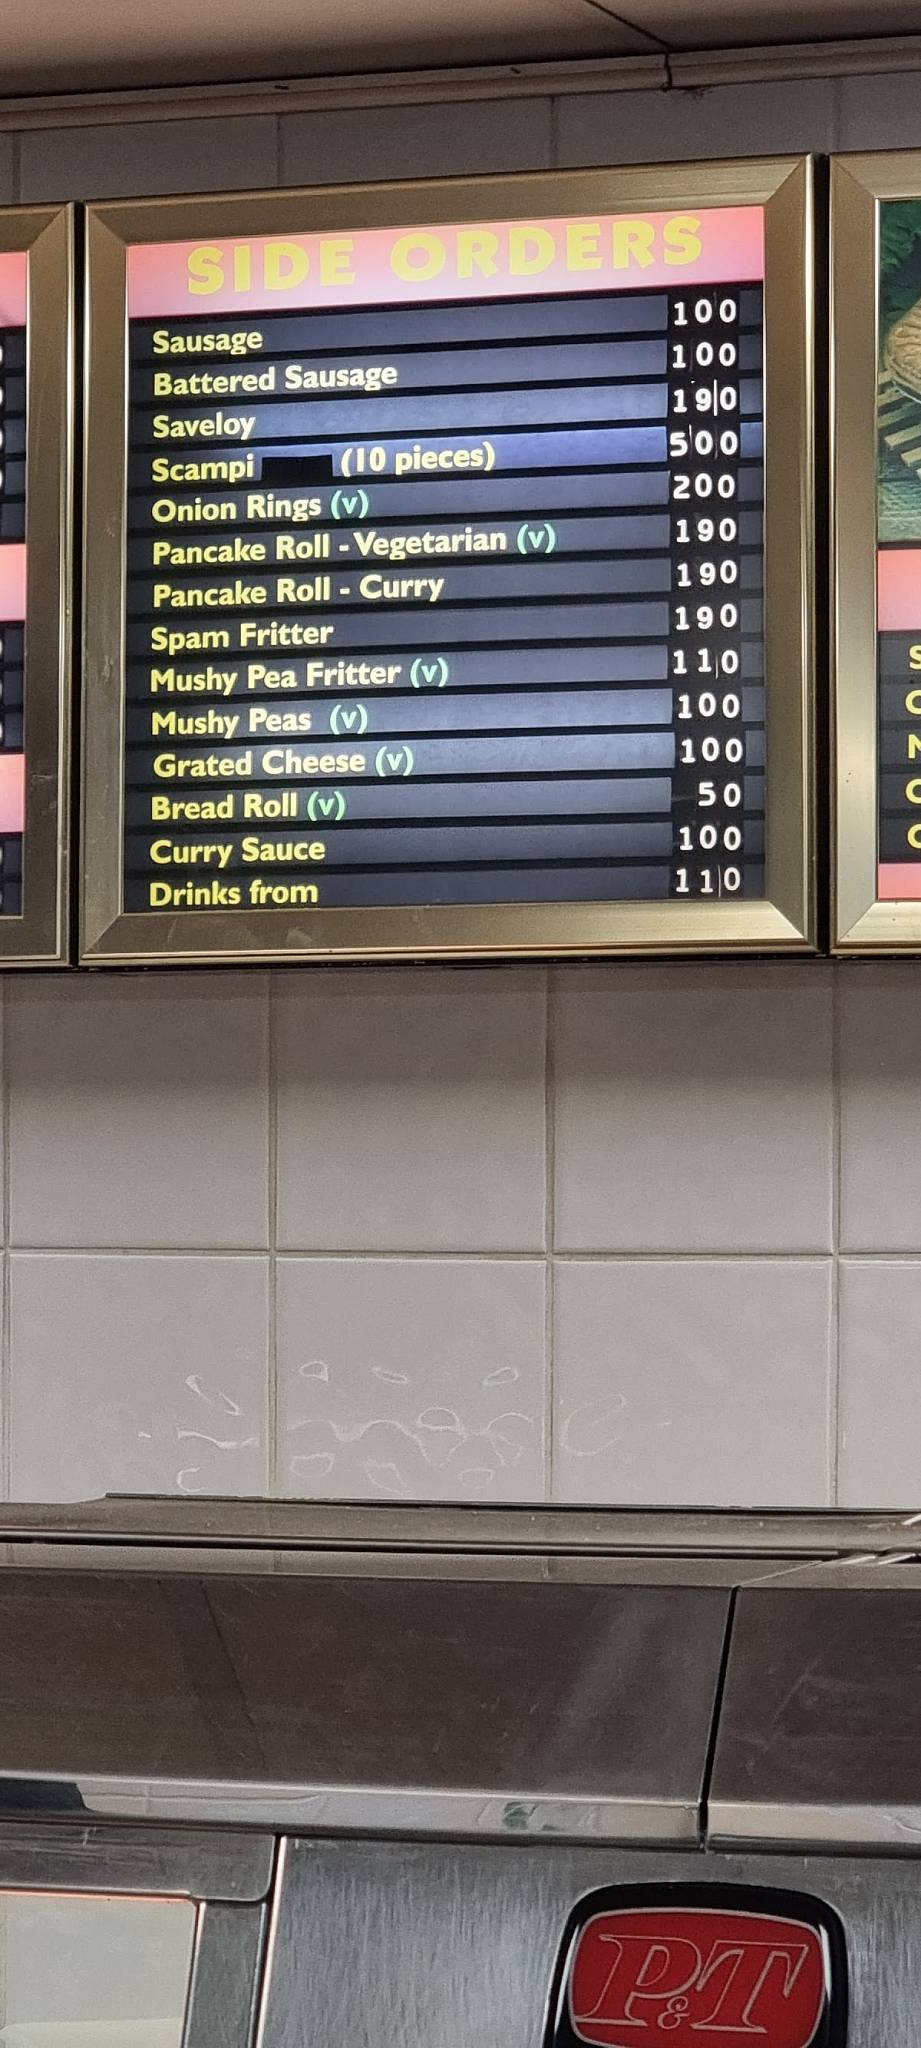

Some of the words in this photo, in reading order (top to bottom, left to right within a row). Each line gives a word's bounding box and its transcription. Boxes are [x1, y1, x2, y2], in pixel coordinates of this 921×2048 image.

[188, 239, 355, 296] SIDE
[391, 216, 702, 283] ORDERS
[153, 330, 263, 355] Sausage
[674, 298, 737, 326] 100
[154, 366, 276, 396] Battered
[284, 364, 399, 392] Sausage
[672, 341, 737, 369] 100
[153, 411, 256, 441] Saveloy
[673, 388, 737, 413] 190
[152, 452, 254, 483] Scampi
[340, 446, 388, 478] (10
[395, 441, 497, 476] pieces)
[669, 430, 738, 457] 500
[151, 497, 237, 523] Onion
[247, 493, 322, 522] Rings
[330, 488, 370, 520] (v)
[673, 472, 736, 500] 200
[153, 537, 266, 565] Pancake
[276, 533, 330, 557] Roll
[352, 526, 508, 561] Vegetarian
[516, 523, 557, 555] (v)
[676, 517, 737, 543] 190
[153, 580, 267, 608] Pancake
[277, 576, 331, 603] Roll
[359, 573, 445, 602] Curry
[677, 559, 738, 587] 190
[151, 626, 230, 656] Spam
[240, 621, 335, 647] Fritter
[675, 603, 738, 631] 190
[150, 666, 238, 696] Mushy
[247, 664, 298, 689] Pea
[306, 660, 403, 687] Fritter
[409, 656, 450, 689] (v)
[673, 648, 739, 675] 110
[152, 709, 240, 739] Mushy
[248, 707, 313, 735] Peas
[329, 703, 369, 735] (v)
[678, 691, 740, 719] 100
[153, 749, 254, 778] Grated
[261, 747, 368, 775] Cheese
[374, 745, 416, 777] (v)
[681, 736, 744, 764] 100
[151, 793, 234, 820] Bread
[243, 791, 298, 818] Roll
[306, 790, 346, 822] (v)
[698, 781, 741, 808] 50
[150, 839, 233, 868] Curry
[241, 836, 326, 862] Sauce
[679, 824, 742, 851] 100
[150, 880, 241, 907] Drinks
[249, 879, 318, 904] from
[675, 866, 741, 893] 110
